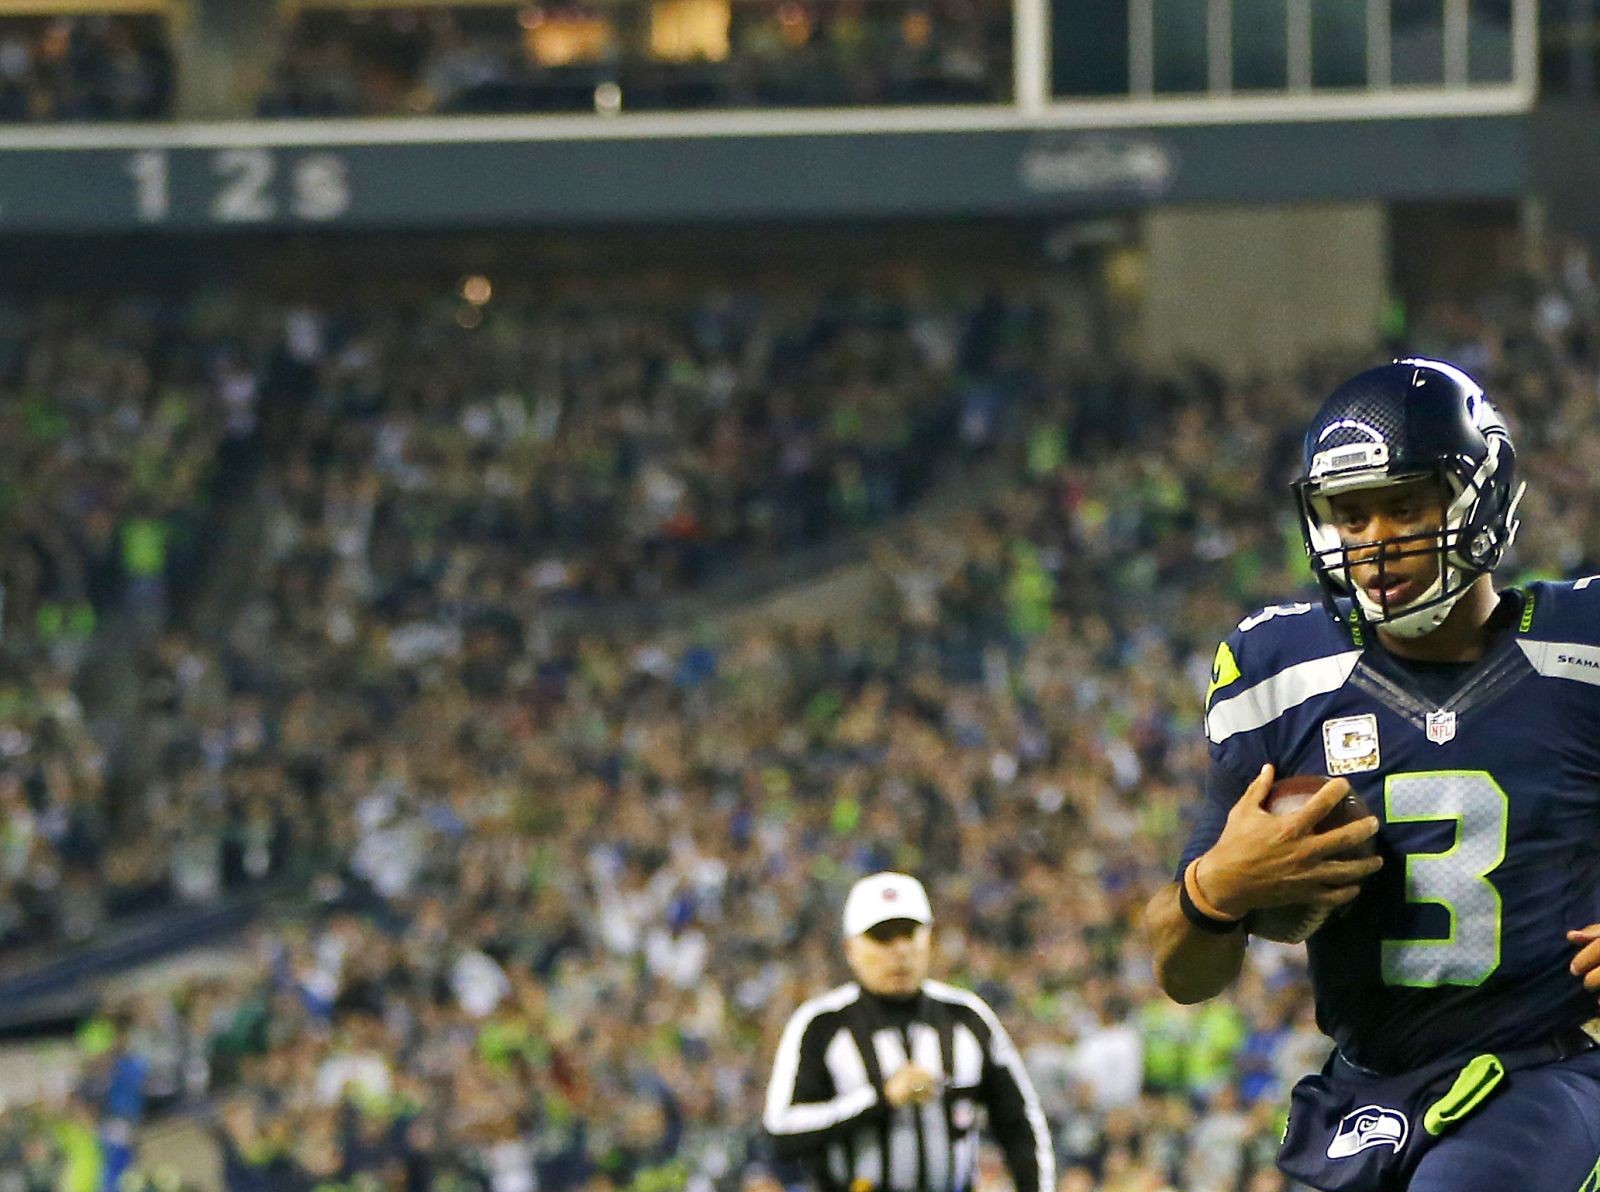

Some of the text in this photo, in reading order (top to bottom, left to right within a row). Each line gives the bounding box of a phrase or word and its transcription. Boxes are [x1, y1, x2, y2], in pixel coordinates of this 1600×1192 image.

[1328, 720, 1377, 760] C
[1430, 724, 1452, 738] NFL
[1381, 769, 1509, 988] 3
